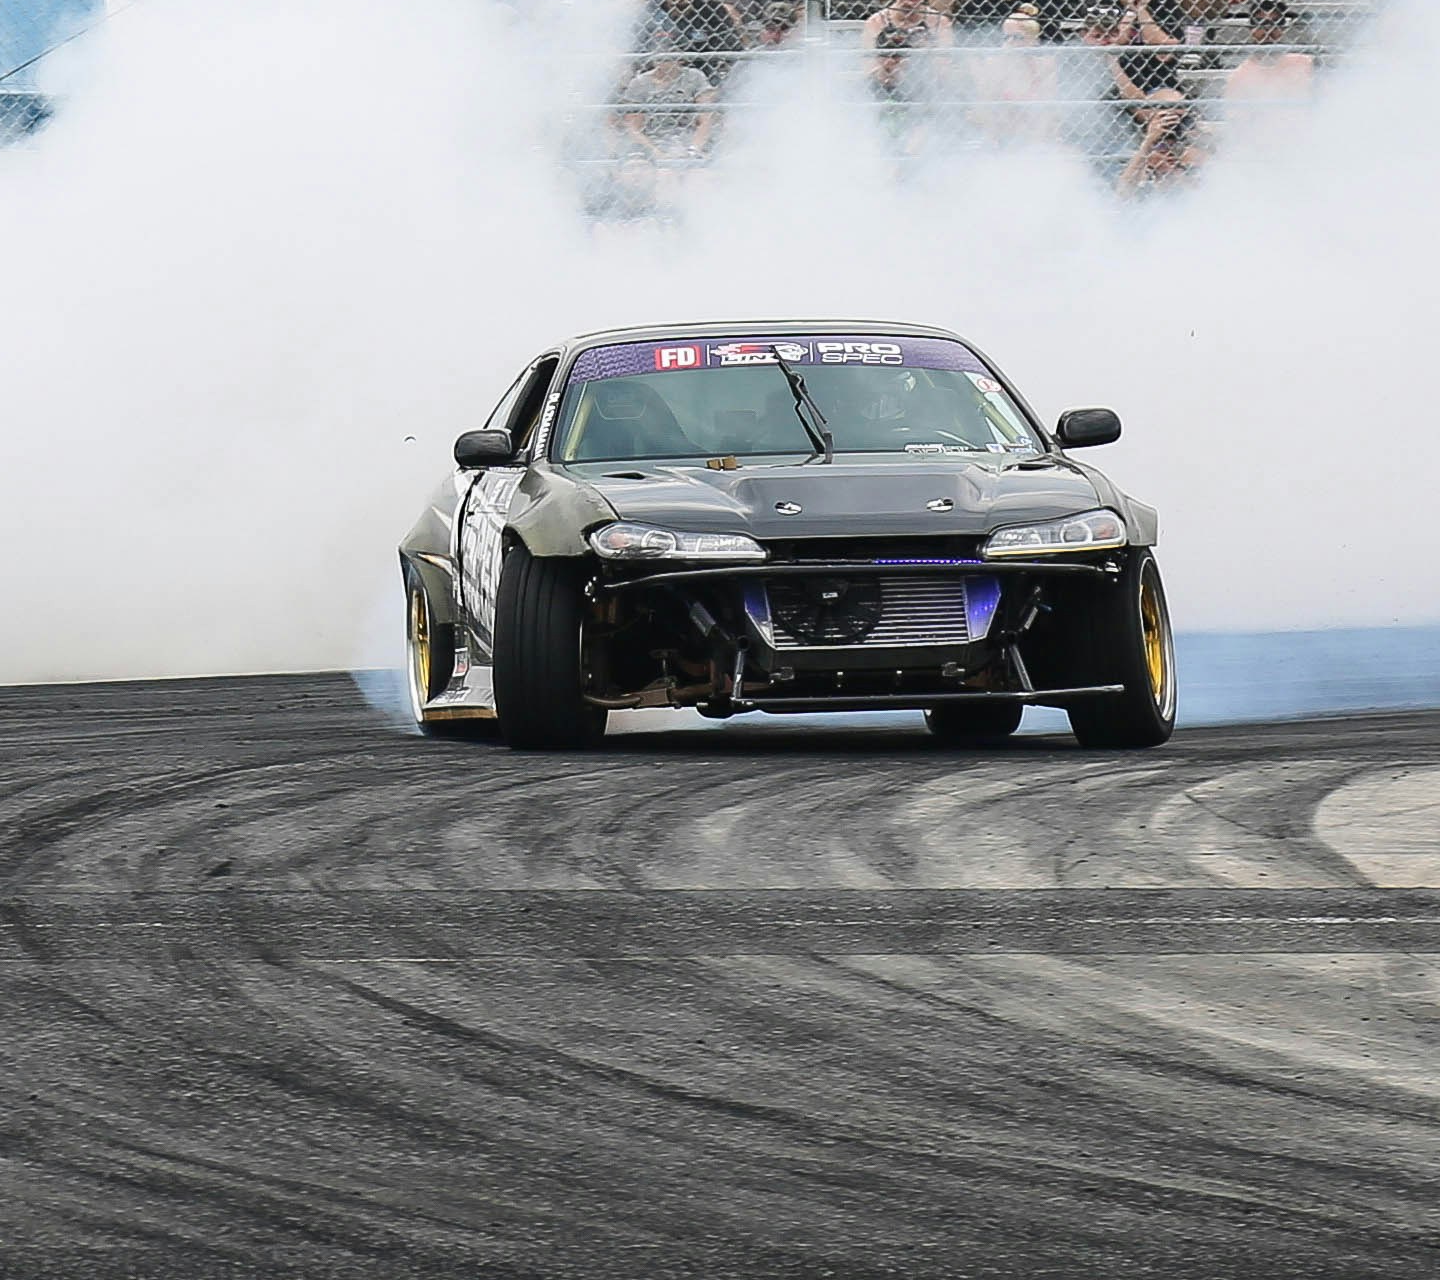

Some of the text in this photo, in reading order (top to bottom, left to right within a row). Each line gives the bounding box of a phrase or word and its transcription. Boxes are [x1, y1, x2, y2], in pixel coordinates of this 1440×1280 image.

[660, 347, 695, 367] FD
[817, 342, 901, 354] PRO
[822, 353, 903, 365] SPEC
